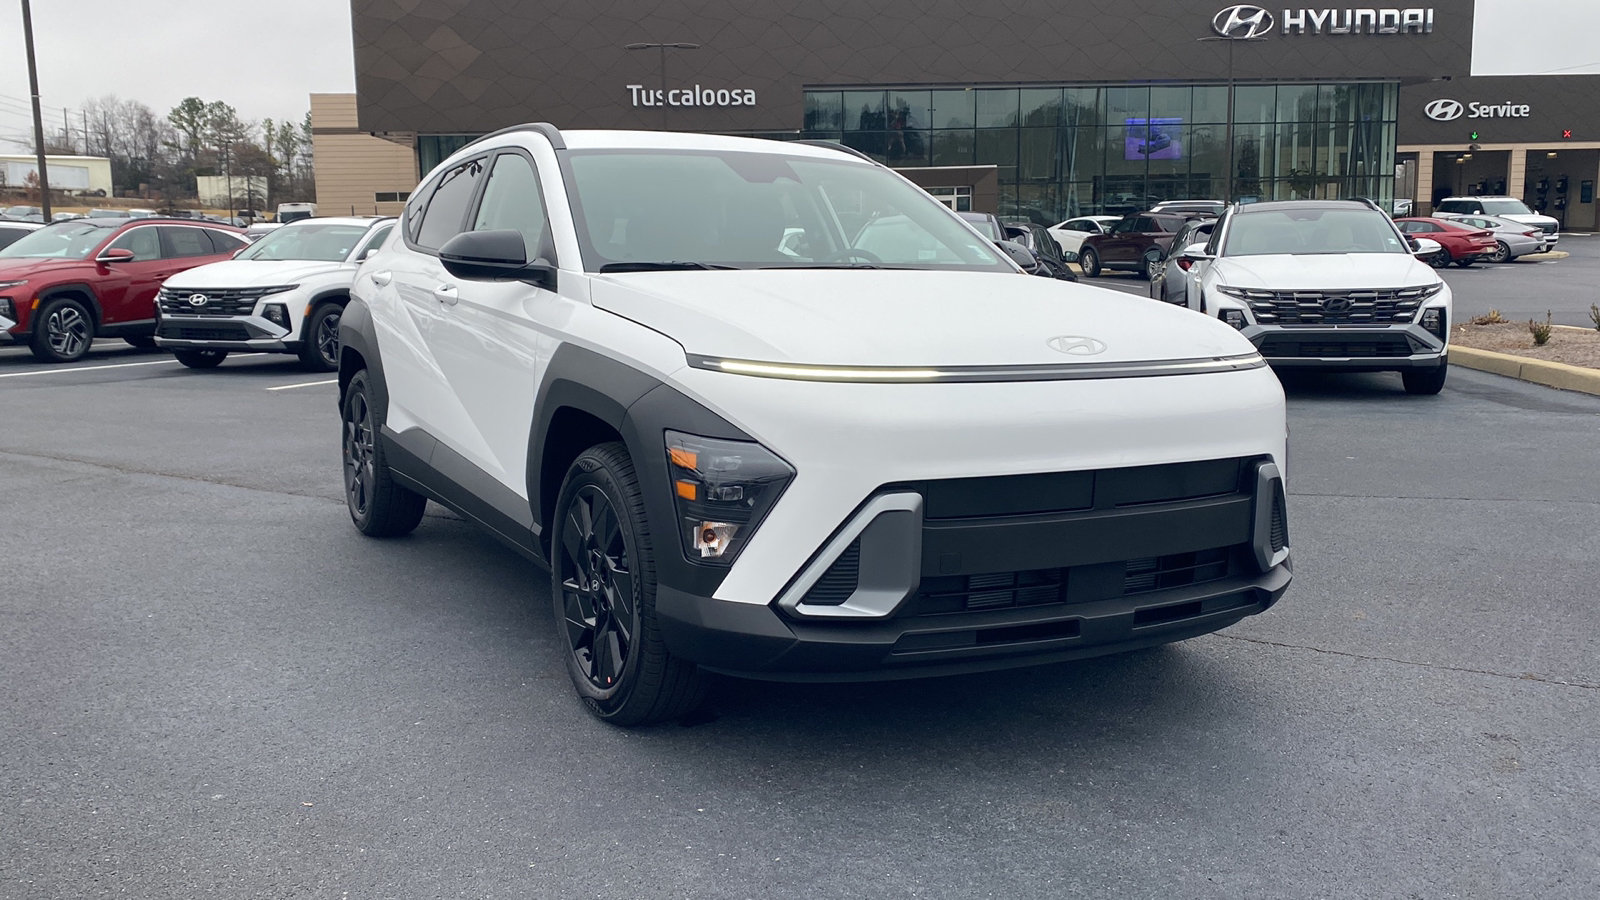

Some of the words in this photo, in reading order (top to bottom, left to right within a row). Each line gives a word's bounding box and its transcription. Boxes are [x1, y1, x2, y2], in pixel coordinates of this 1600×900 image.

[1281, 8, 1434, 35] HYUNDAI
[626, 84, 756, 107] Tuscaloosa
[1467, 100, 1530, 118] Service
